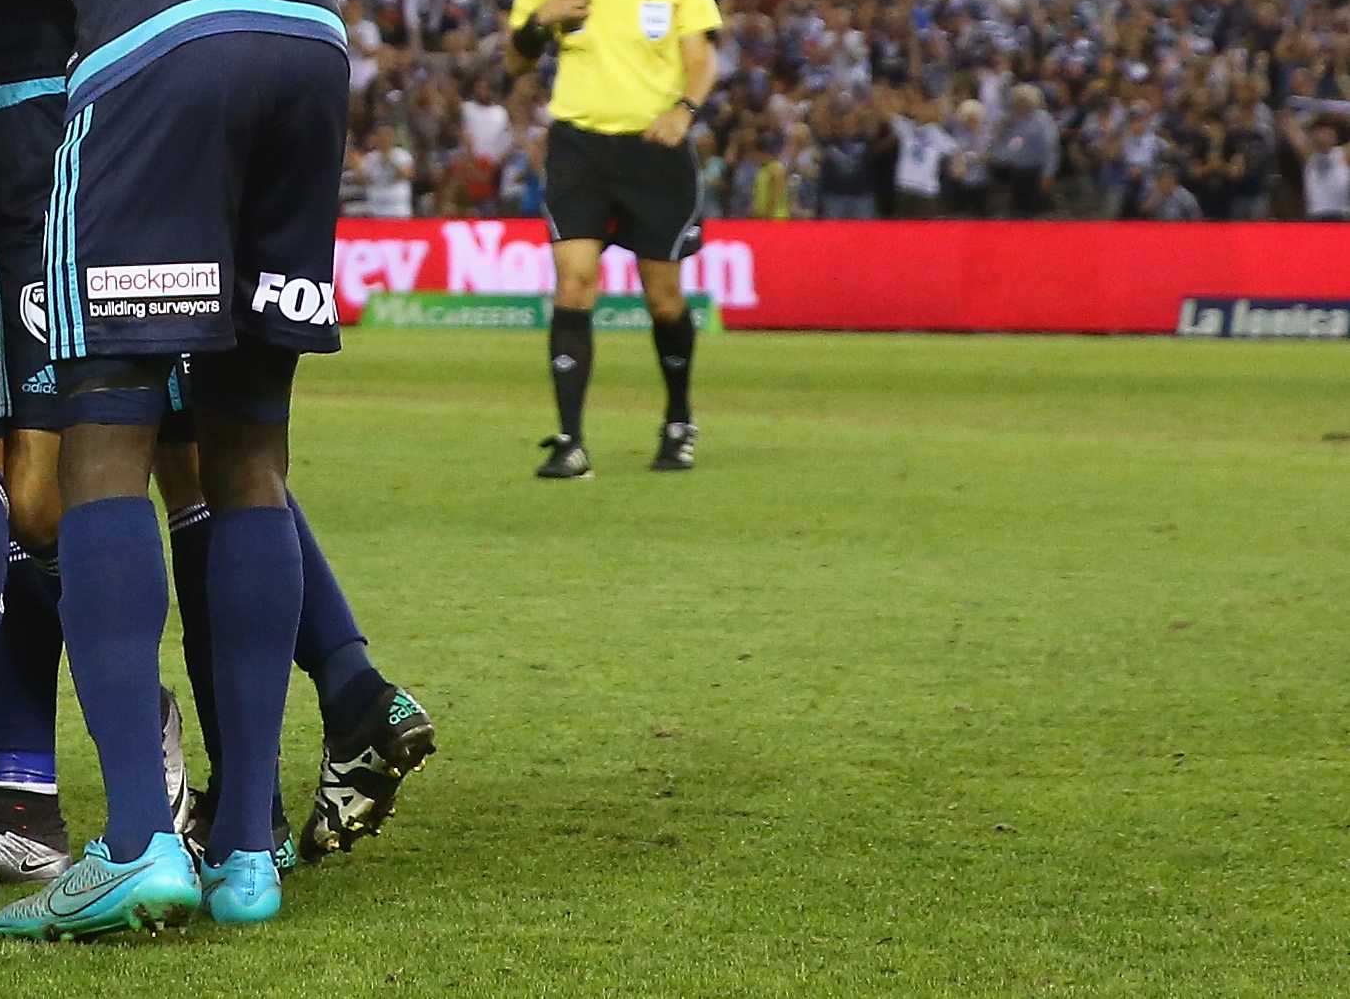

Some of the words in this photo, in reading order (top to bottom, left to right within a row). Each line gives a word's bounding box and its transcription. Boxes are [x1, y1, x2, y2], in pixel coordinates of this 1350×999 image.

[90, 266, 217, 294] checkpoint
[89, 301, 146, 318] building
[149, 300, 220, 316] surveyors
[251, 271, 338, 325] FOX
[1178, 298, 1224, 335] La
